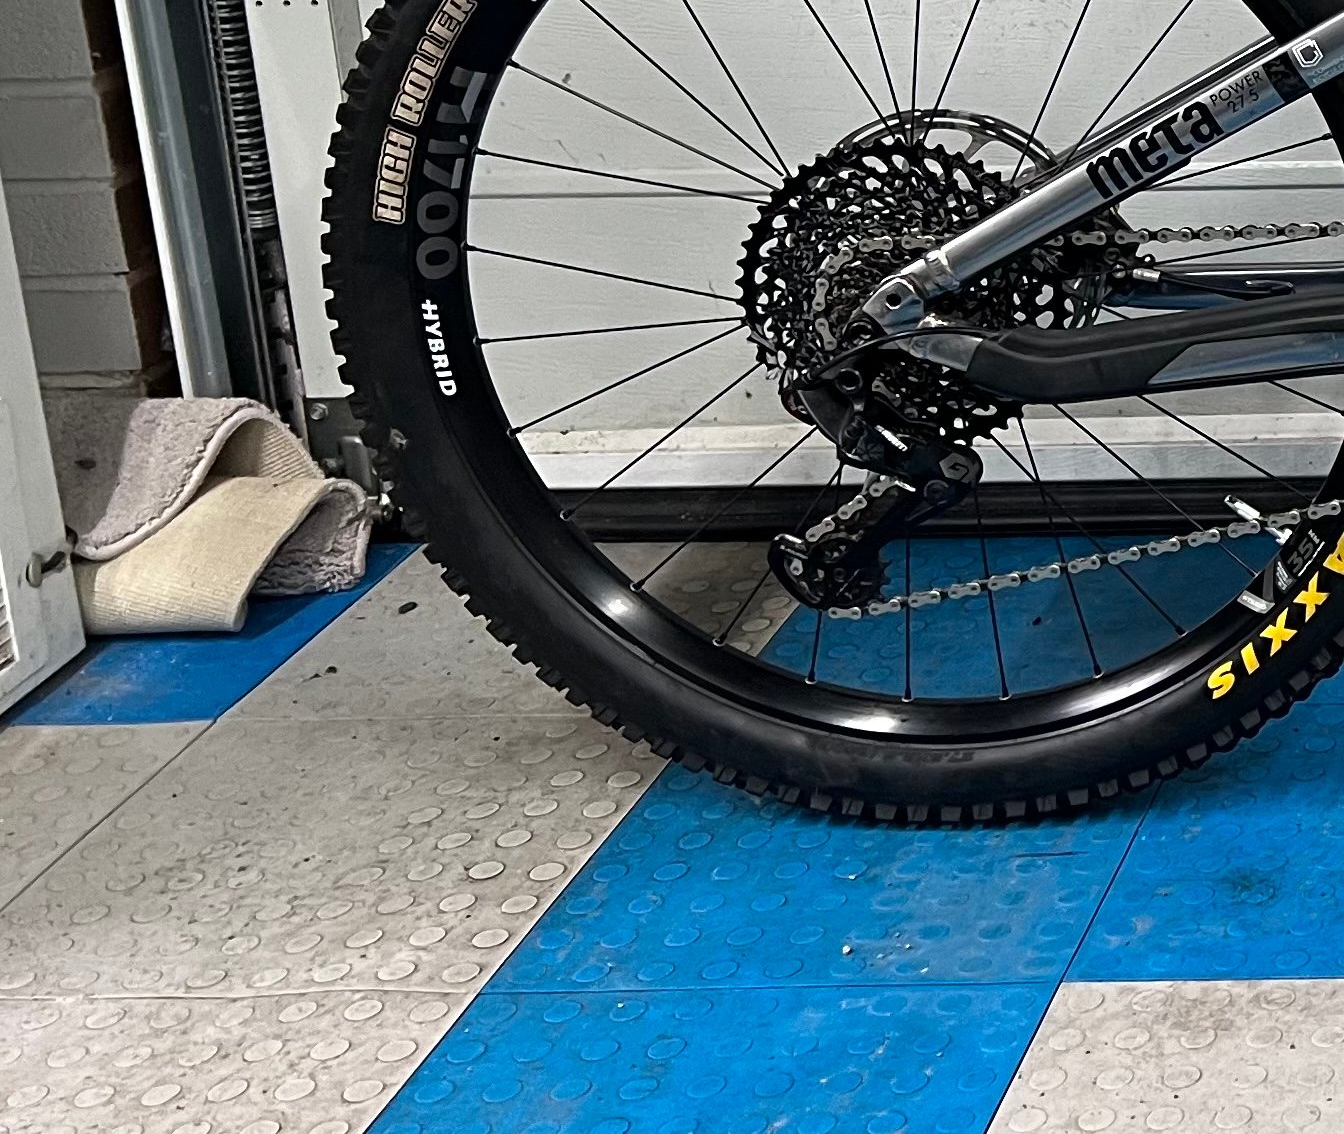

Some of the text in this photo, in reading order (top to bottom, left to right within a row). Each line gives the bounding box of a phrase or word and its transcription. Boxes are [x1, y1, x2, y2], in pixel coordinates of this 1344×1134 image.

[1209, 70, 1264, 106] POWER
[372, 127, 416, 225] HIGH
[1086, 101, 1225, 200] meta
[421, 298, 458, 399] HYBRID
